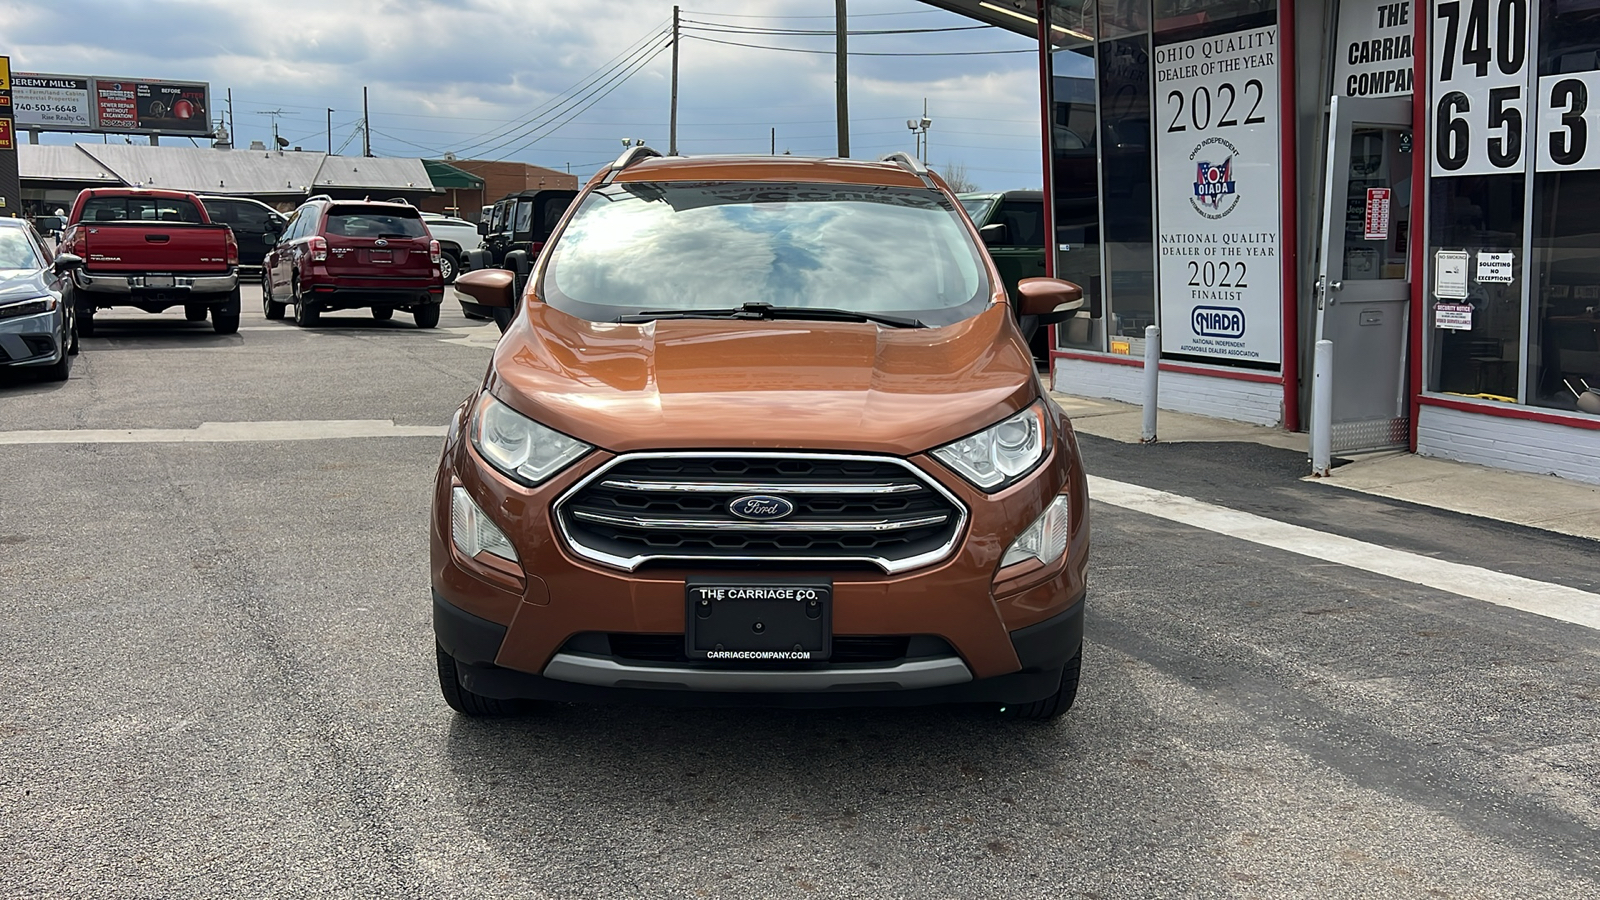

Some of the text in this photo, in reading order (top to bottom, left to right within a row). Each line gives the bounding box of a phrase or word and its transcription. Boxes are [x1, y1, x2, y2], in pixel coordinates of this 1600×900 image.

[1378, 2, 1409, 28] THE
[1156, 45, 1195, 64] OHIO
[1202, 30, 1276, 59] QUALITY
[1437, 0, 1527, 82] 740
[1348, 34, 1414, 65] CARRIA
[1158, 52, 1274, 82] DEALER OF THE YEAR
[11, 78, 47, 87] JEREMY
[49, 80, 76, 88] MILLS
[15, 103, 77, 112] 740-503-6648
[1167, 79, 1265, 133] 2022
[56, 114, 75, 123] Realty
[1189, 137, 1240, 160] OHIO INDEPENDENT
[1198, 182, 1228, 195] OIADA
[1189, 197, 1208, 218] AUTOMOBILE
[1222, 194, 1241, 217] ASSOCIATION
[1161, 233, 1276, 245] NATIONAL QUALITY
[1162, 247, 1275, 256] DEALER OF THE YEAR
[1187, 261, 1248, 288] 2022
[1191, 290, 1243, 301] FINALIST
[1196, 312, 1240, 333] NIADA
[1215, 340, 1246, 348] INDEPENDENT
[1181, 345, 1259, 357] AUTOMOBILE DEALERS ASSOCIATION
[743, 500, 779, 514] Ford
[700, 589, 818, 600] THE CARRIAGE CO.
[707, 651, 810, 660] CARRIAGECOMPANY.COM
